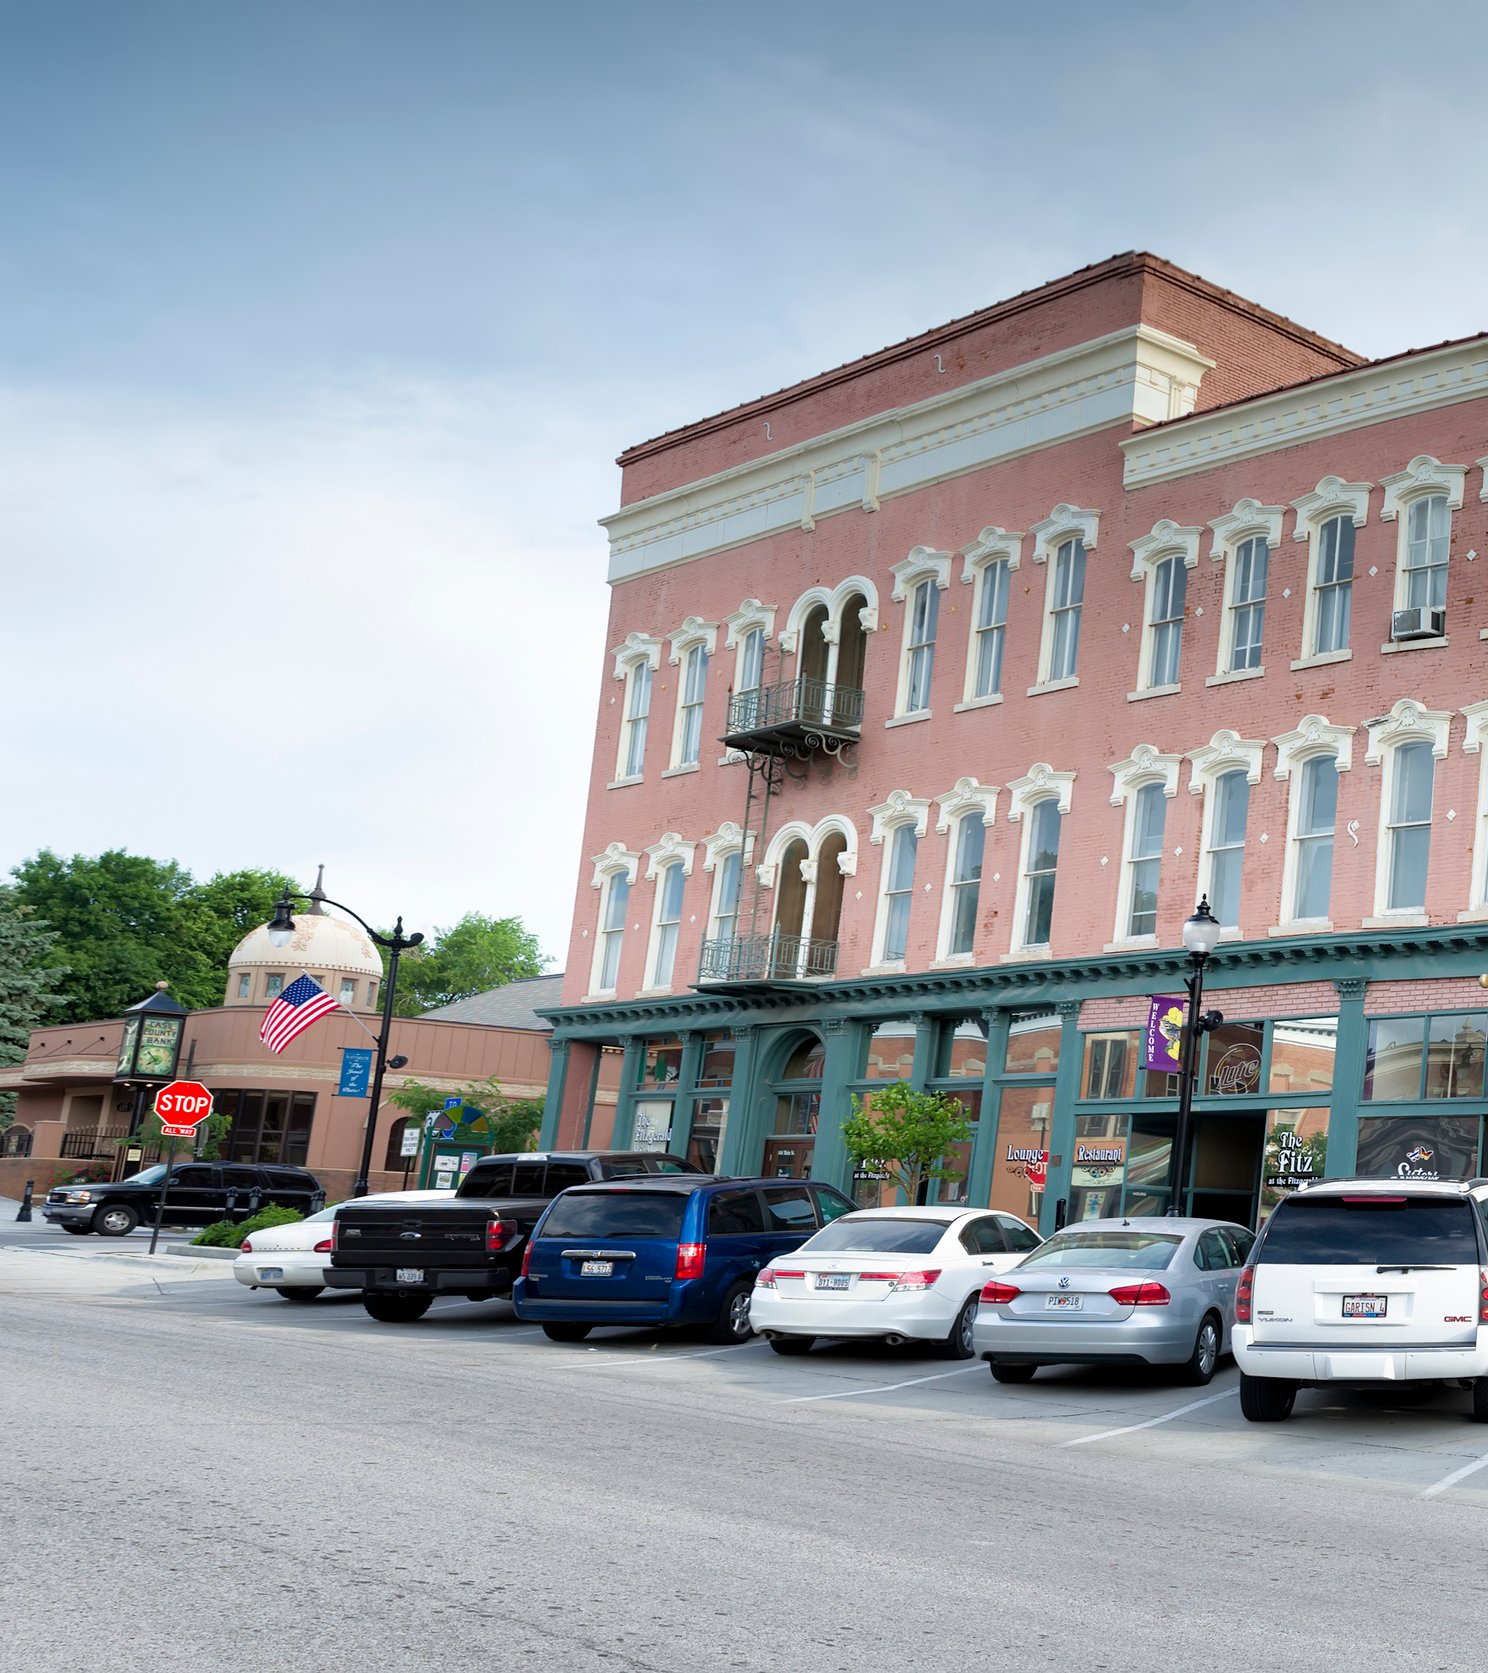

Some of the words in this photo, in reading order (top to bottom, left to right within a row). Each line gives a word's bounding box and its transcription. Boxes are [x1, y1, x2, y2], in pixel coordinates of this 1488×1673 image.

[147, 1037, 173, 1045] BANK
[1148, 1003, 1160, 1062] WELCOME
[1216, 1059, 1260, 1090] Lite
[160, 1094, 209, 1114] STOP
[164, 1126, 177, 1134] ALL
[179, 1127, 193, 1135] WAY
[1279, 1131, 1303, 1150] The
[1006, 1144, 1044, 1166] Lounge
[1078, 1143, 1122, 1164] Restaurant
[1277, 1149, 1314, 1174] Fitz
[1268, 1177, 1276, 1185] at
[1276, 1176, 1286, 1186] the
[1345, 1302, 1376, 1313] GARISN
[1379, 1302, 1385, 1313] 4
